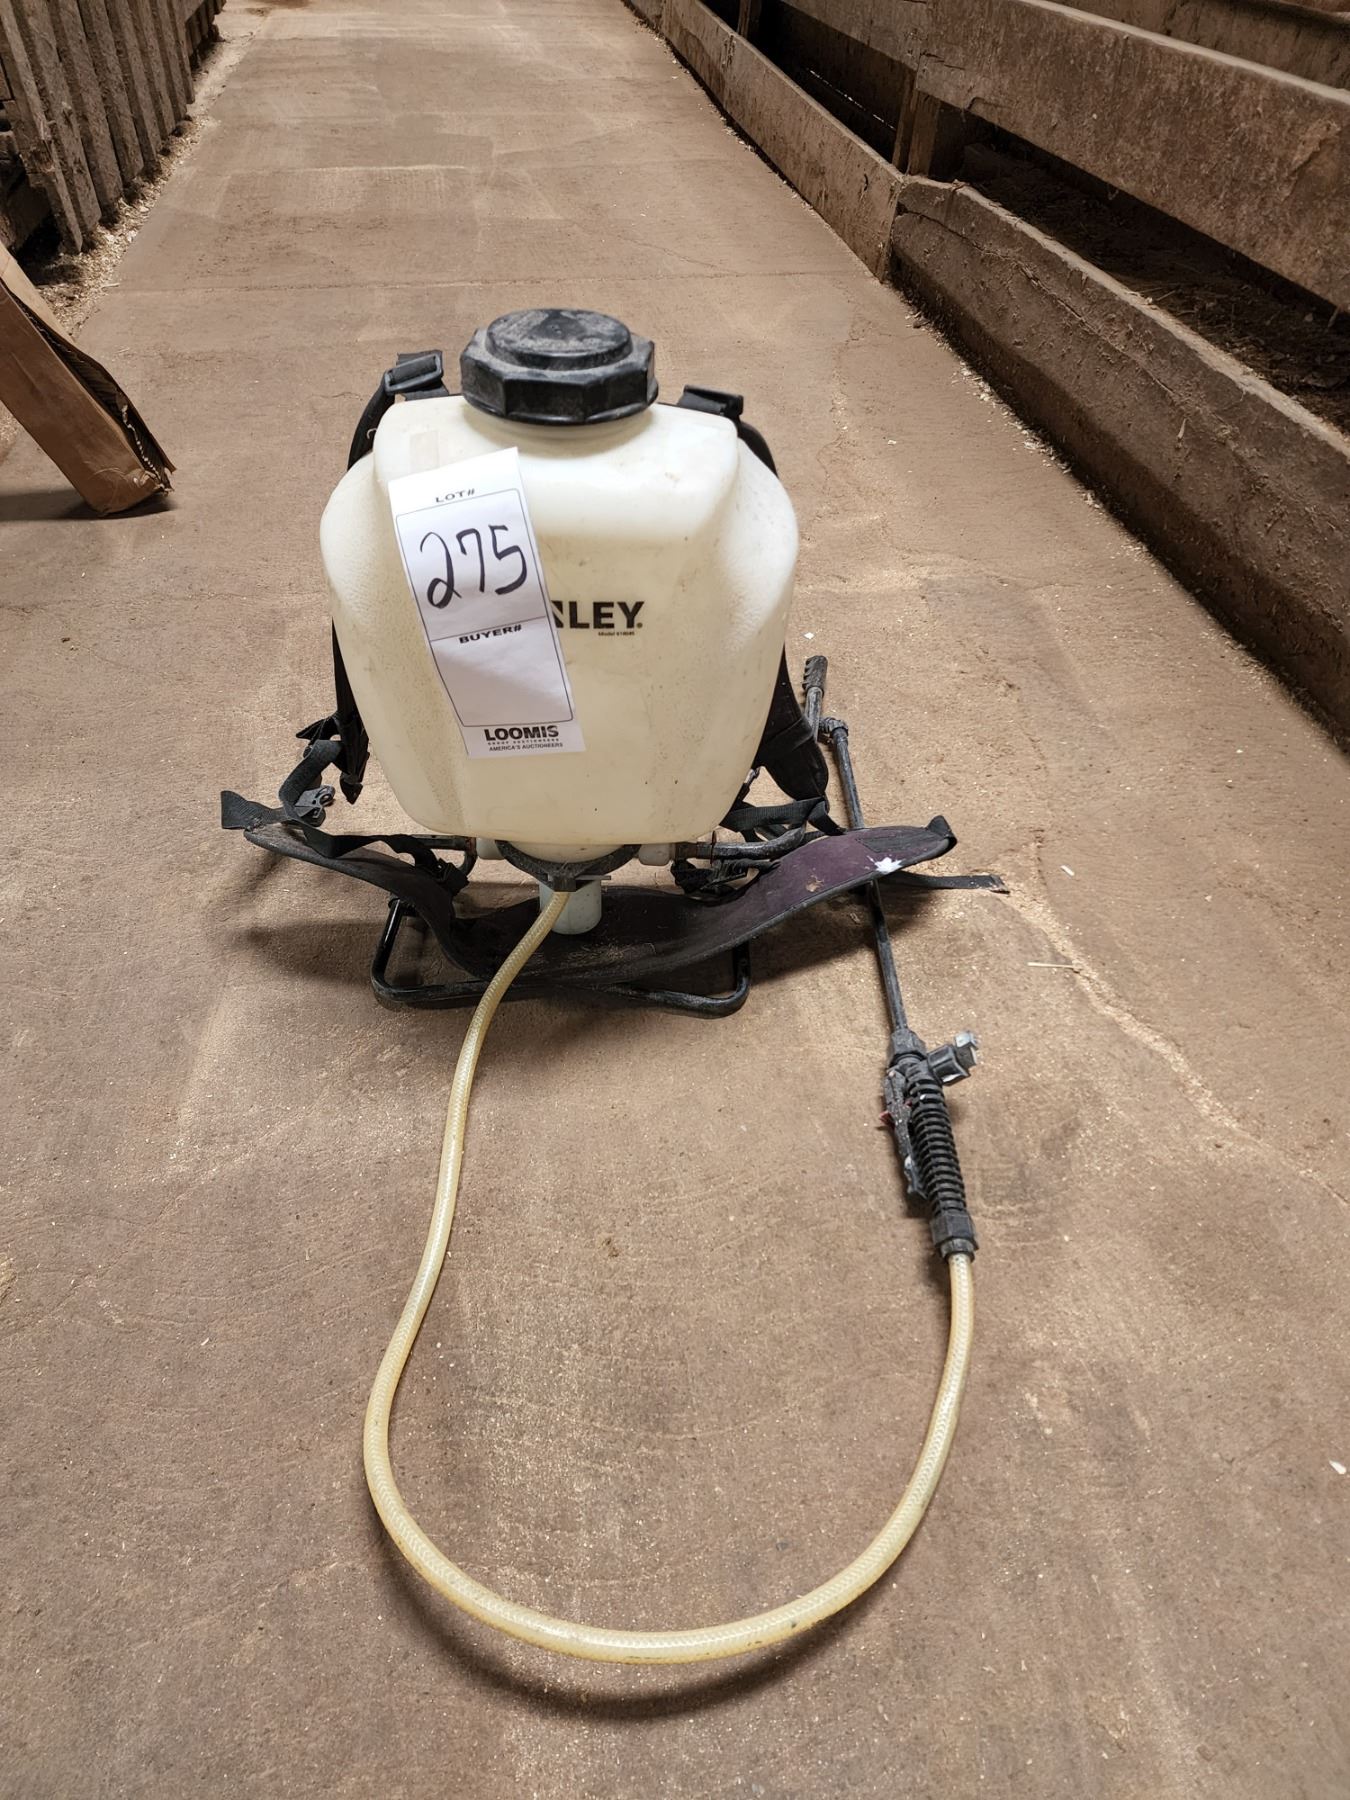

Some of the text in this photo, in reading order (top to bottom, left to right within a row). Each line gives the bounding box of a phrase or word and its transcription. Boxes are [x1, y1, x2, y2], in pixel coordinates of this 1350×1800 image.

[435, 488, 475, 503] LOT#
[420, 525, 527, 609] 275
[459, 624, 522, 644] BUYER#
[484, 725, 559, 741] LOOMIS
[489, 744, 521, 752] AMERICA'S
[522, 742, 564, 750] AUCTIONEERS
